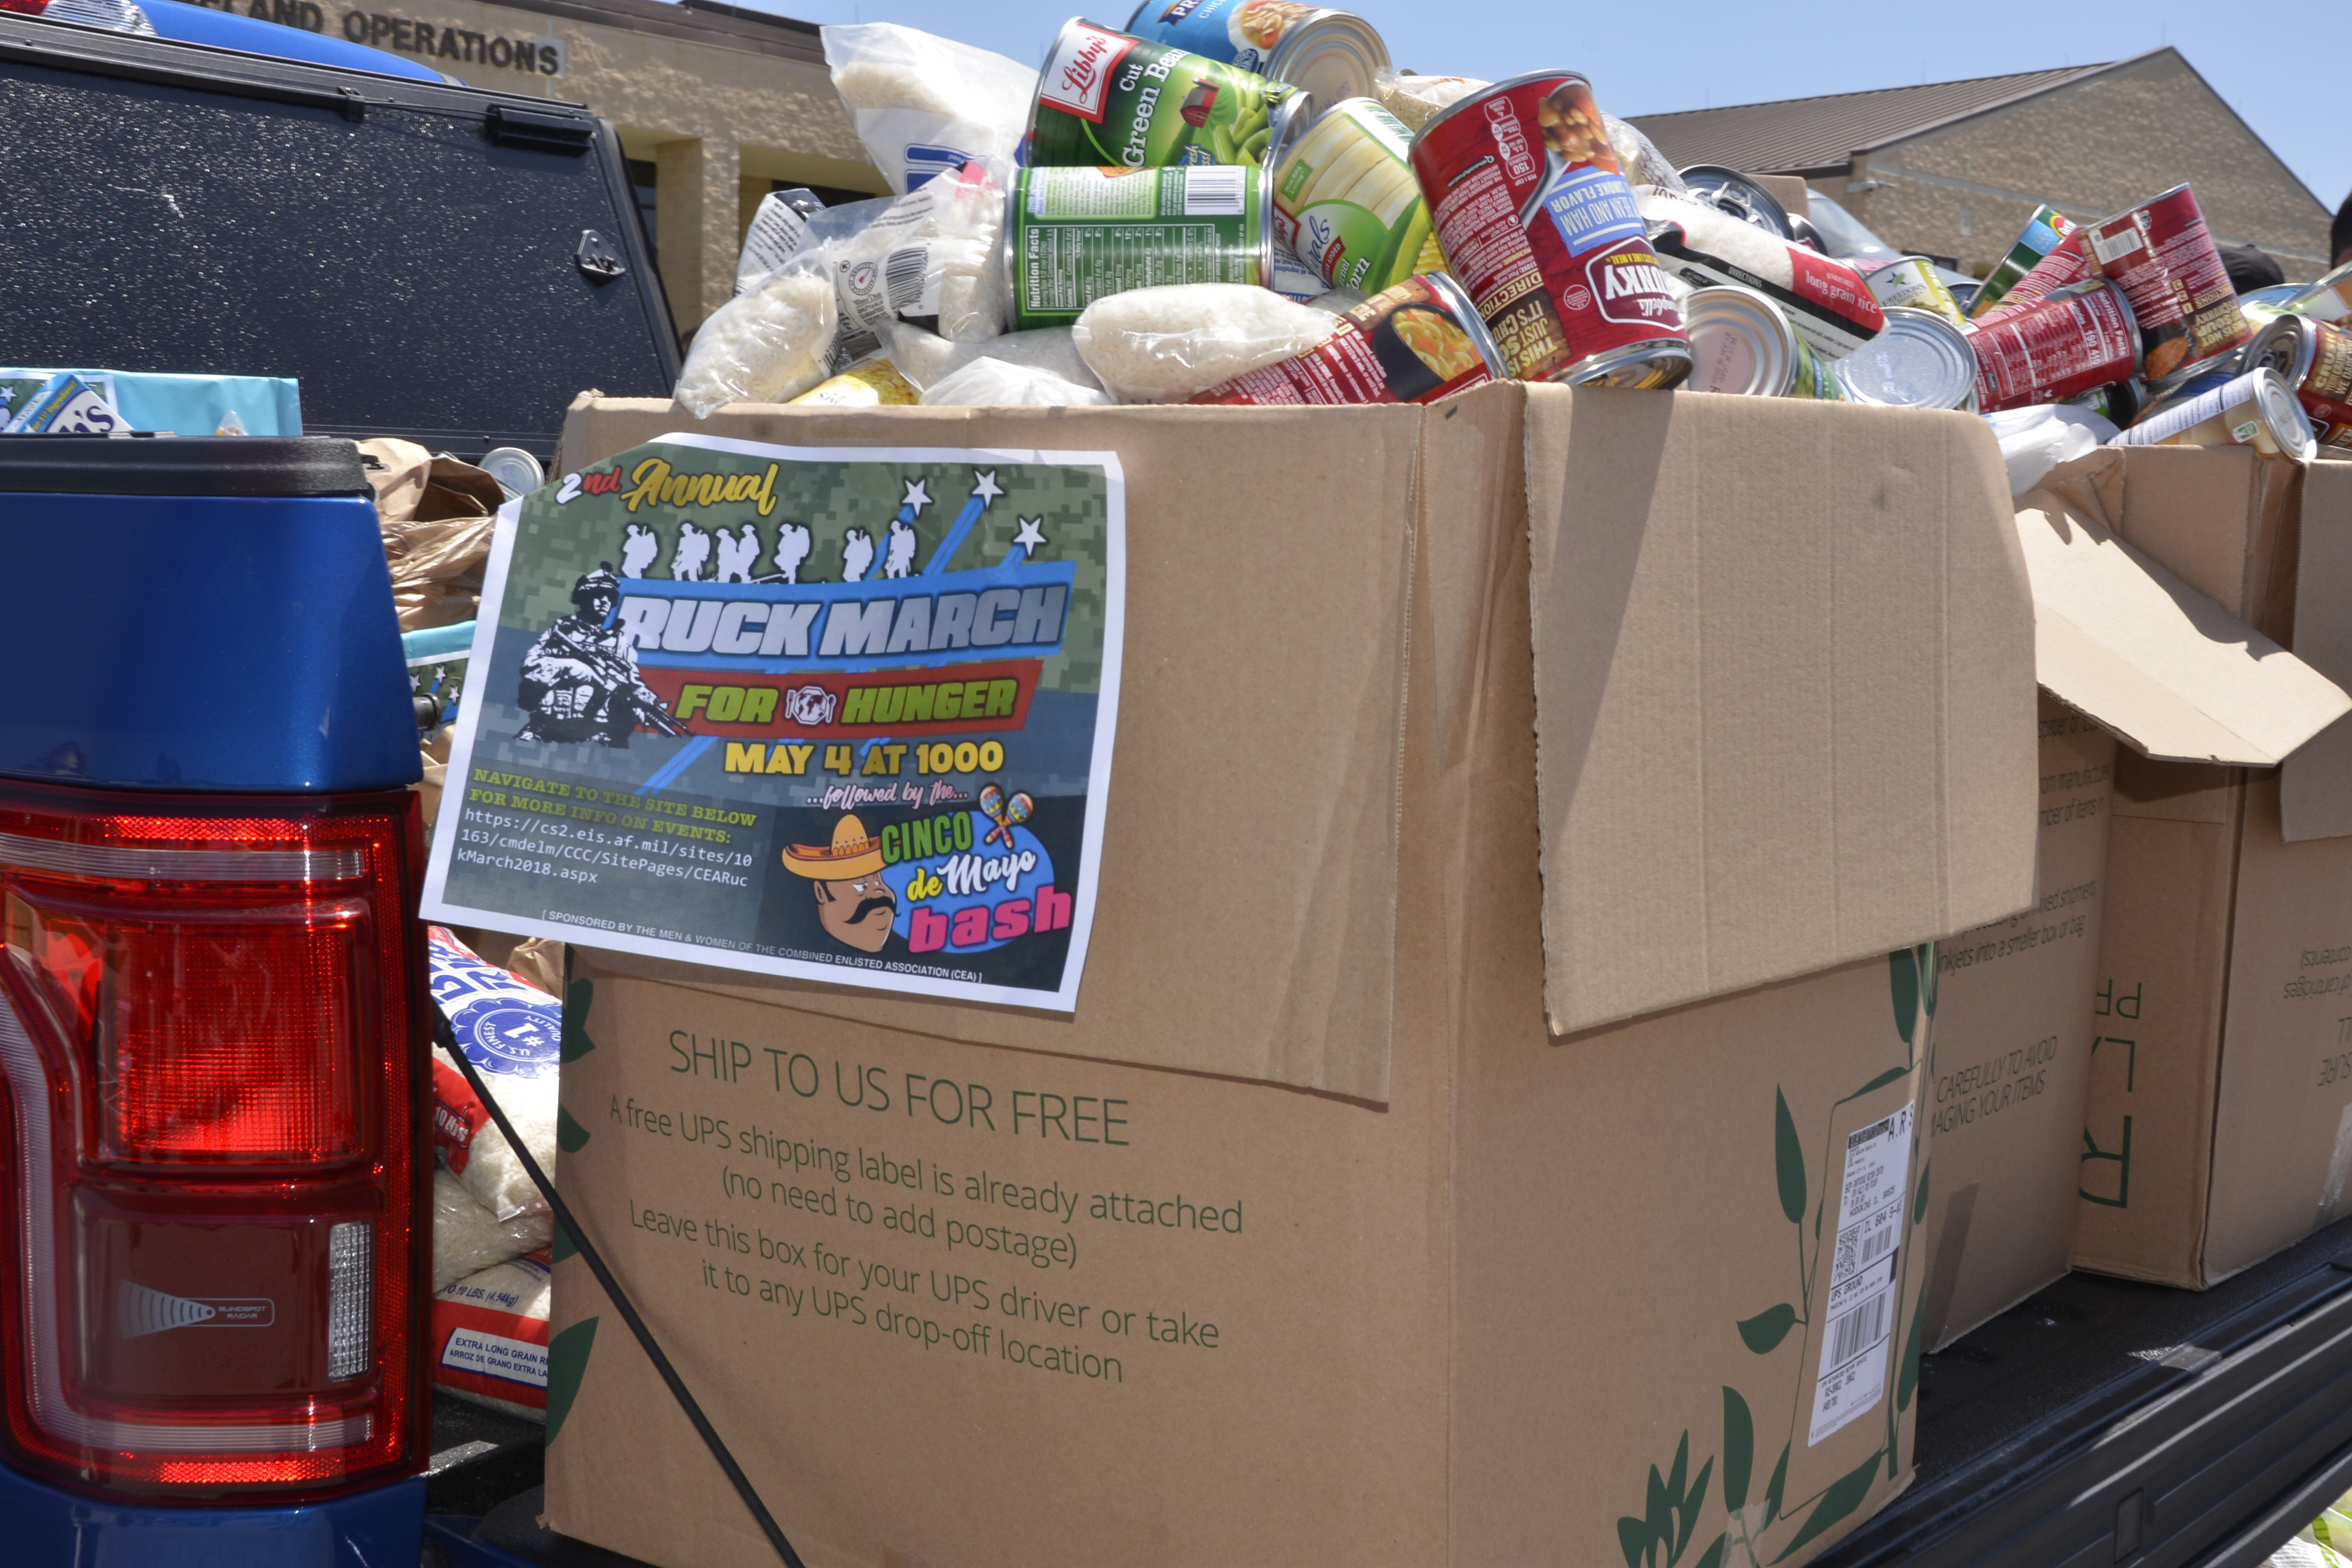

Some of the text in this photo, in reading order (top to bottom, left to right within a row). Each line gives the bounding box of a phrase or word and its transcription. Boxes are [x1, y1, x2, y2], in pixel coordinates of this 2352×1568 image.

[247, 0, 559, 75] AND OPERATIONS
[1061, 36, 1107, 104] Libby's
[1119, 64, 1144, 92] Cut
[1122, 84, 1161, 167] Green
[1284, 166, 1303, 191] Non-BPA
[1513, 162, 1530, 174] 150
[1550, 186, 1597, 213] FLAVOR
[1560, 207, 1593, 237] HAM
[1588, 199, 1614, 225] AND
[1028, 228, 1040, 307] Nutrition Facts
[1328, 243, 1341, 263] ADDED
[1502, 247, 1532, 265] MICROWAVE:
[1520, 261, 1537, 273] STOVE:
[1728, 267, 1762, 288] DIRECTIONS
[1805, 270, 1878, 314] long grain rice
[1827, 272, 1854, 288] ENRICHED
[1517, 301, 1544, 326] IT'S
[1520, 318, 1548, 347] JUST
[2096, 290, 2127, 357] Nutrition Facts
[1520, 336, 1557, 367] THIS
[2316, 332, 2336, 388] CRUSH
[556, 458, 778, 515] 2nd Annual
[621, 586, 1067, 656] RUCK MARCH
[675, 679, 1018, 724] FOR HUNGER
[724, 741, 1004, 774] MAY 4 AT 1000
[468, 788, 731, 844] FOR MORE INFO ON EVENTS:
[473, 768, 757, 827] NAVIGATE TO THE SITE BELOW
[902, 782, 923, 809] by
[461, 829, 749, 888] 163/cmdelm/CCC/SitePages/CEARuc
[464, 808, 752, 868] https://cs2.eis.af.mil/sites/10
[881, 811, 972, 863] CINCO
[457, 849, 598, 884] kMarch2018.aspx
[907, 849, 1036, 901] de Mayo
[909, 884, 1071, 953] bash
[1976, 941, 1996, 963] into
[2008, 927, 2041, 955] smaller
[2041, 922, 2057, 945] box
[2071, 914, 2085, 937] bag
[549, 911, 976, 983] SPONSORED BY THE MEN & WOMEN OF THE COMBINED ENLISTED ASSOCIATION (CEA)
[2284, 976, 2339, 1001] cartridges
[483, 1022, 506, 1051] FINEST
[669, 1030, 1129, 1146] SHIP TO US FOR FREE
[1937, 1036, 2058, 1103] CAREFULLY TO AVOID
[1979, 1070, 2046, 1119] YOUR ITEMS
[610, 1094, 1242, 1233] A free UPS shipping label is already attached
[722, 1165, 1077, 1269] (no need to add postage)
[630, 1199, 1220, 1349] Leave this box for your UPS driver or take
[1831, 1287, 1842, 1301] UPS
[1843, 1276, 1863, 1297] GROUND
[702, 1258, 1123, 1383] it to any UPS drop-off location
[449, 1349, 474, 1362] ARROZ
[487, 1356, 512, 1369] GRANO
[513, 1363, 536, 1376] EXTRA
[455, 1337, 537, 1362] EXTRA LONG GRAIN
